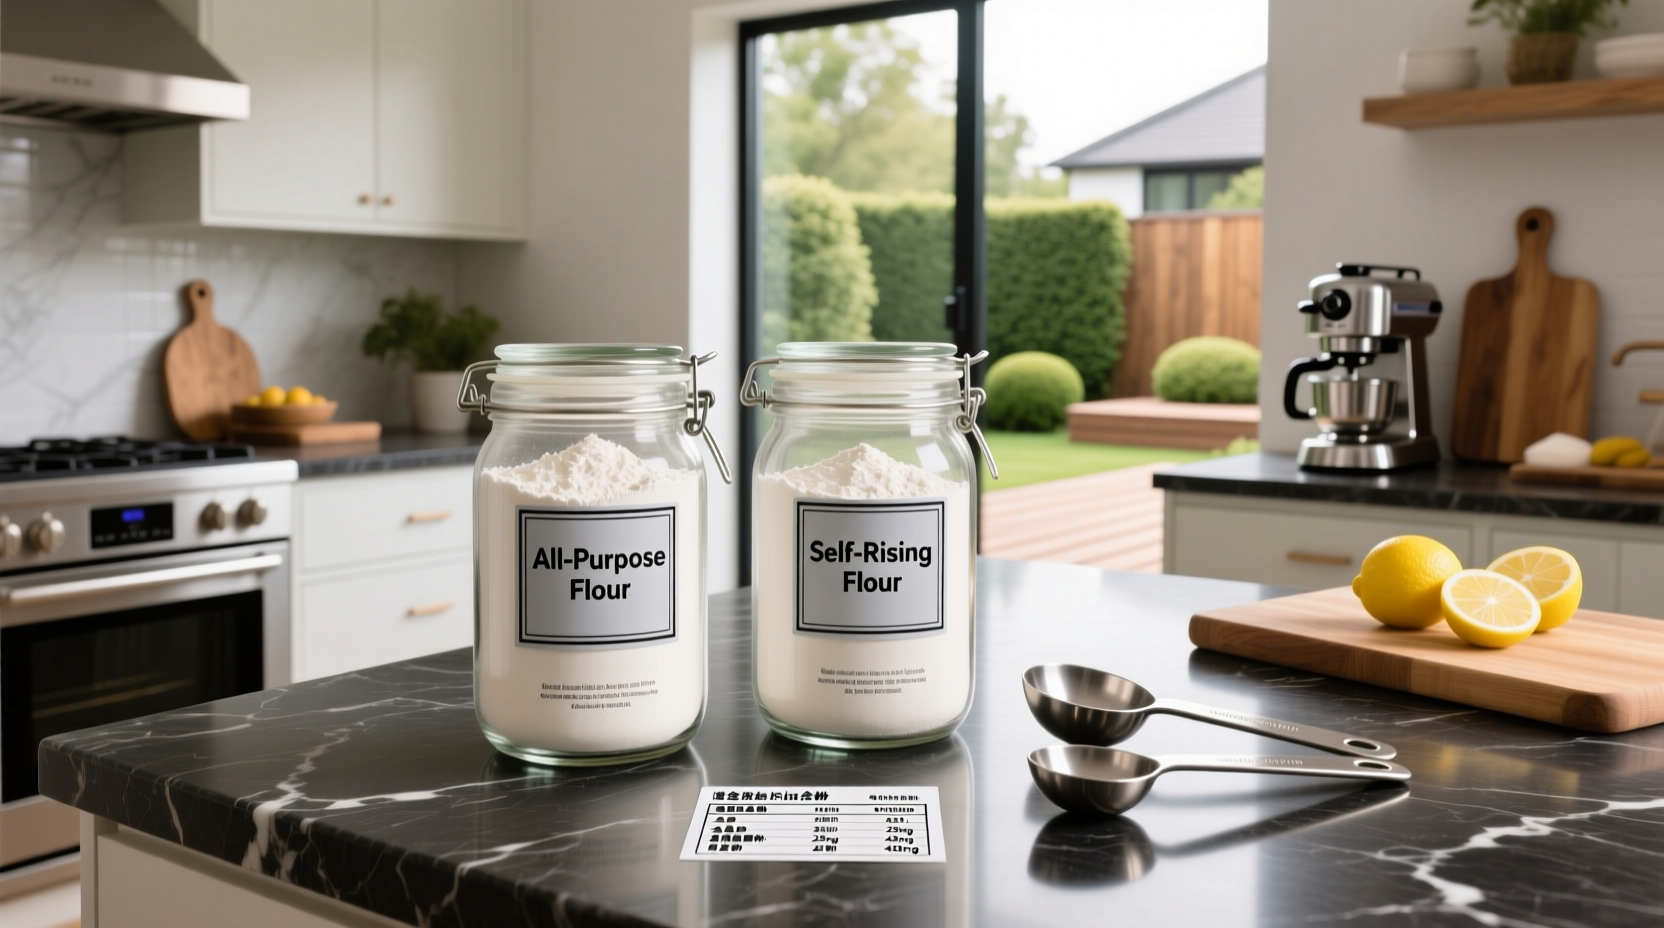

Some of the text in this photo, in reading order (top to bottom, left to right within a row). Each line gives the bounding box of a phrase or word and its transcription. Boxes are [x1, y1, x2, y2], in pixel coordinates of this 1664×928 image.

[532, 547, 666, 575] All-Purpose
[810, 540, 932, 568] Self-Rising
[570, 578, 631, 601] Flour
[843, 570, 903, 593] Flour
